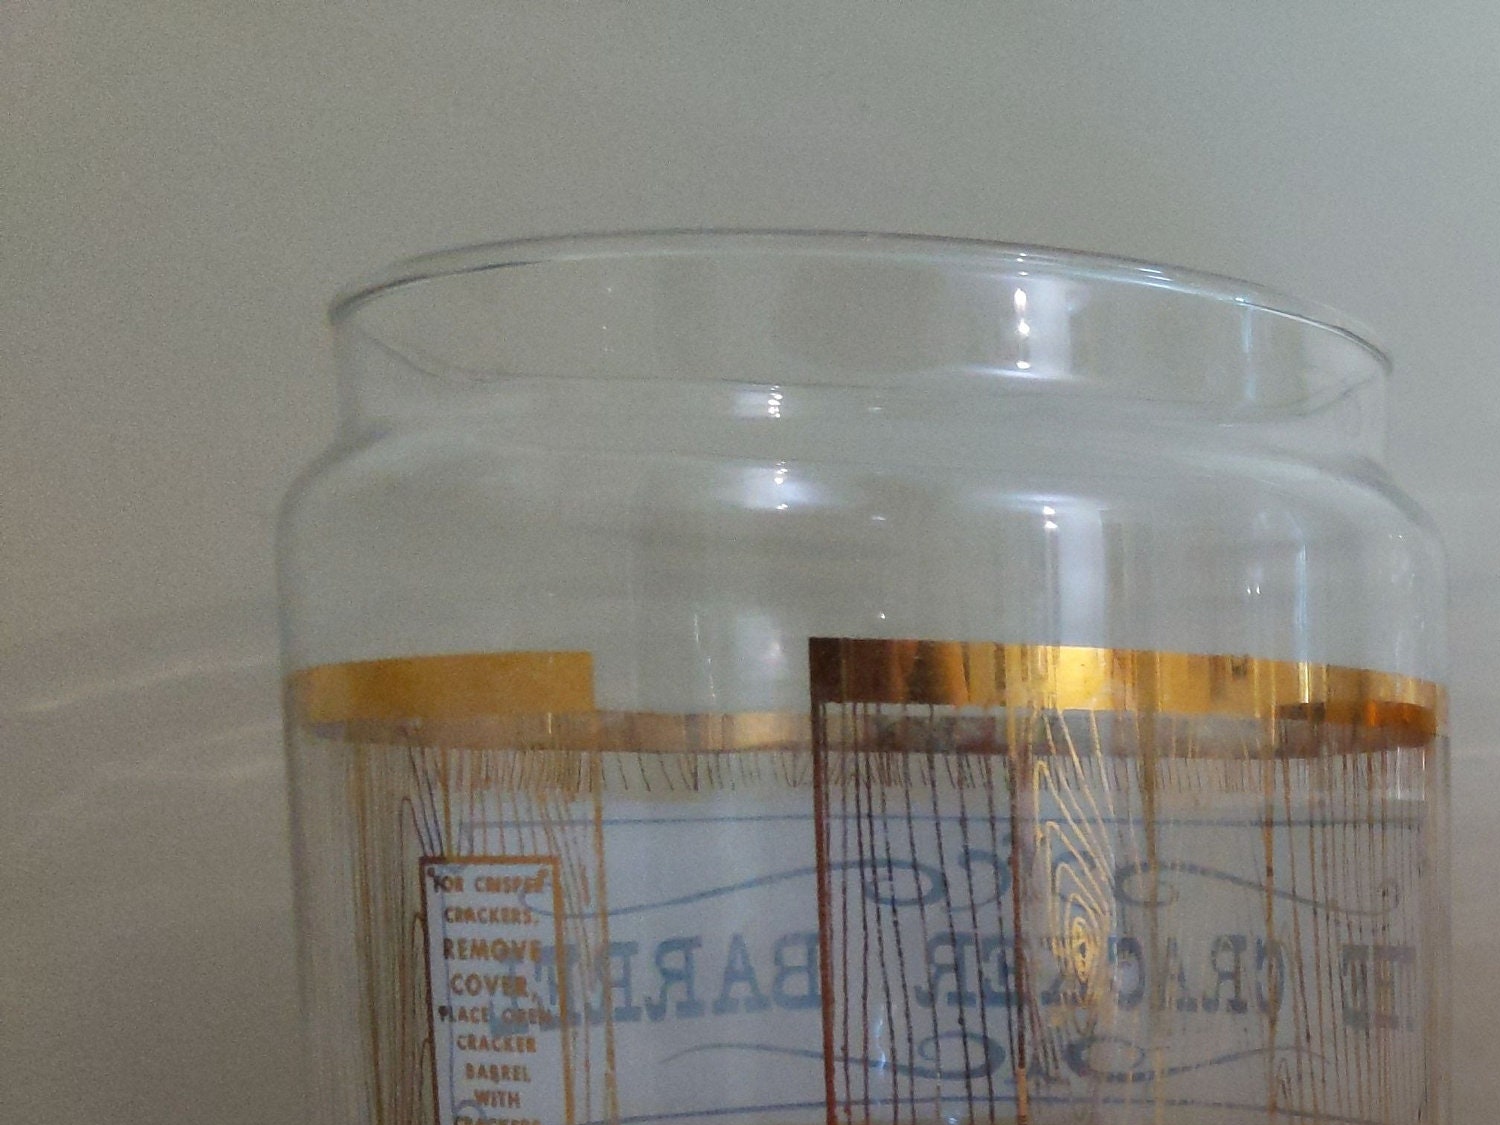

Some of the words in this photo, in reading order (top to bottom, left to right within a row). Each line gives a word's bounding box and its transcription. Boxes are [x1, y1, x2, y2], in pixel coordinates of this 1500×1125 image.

[443, 937, 543, 965] REMOVE
[456, 1033, 537, 1054] CRACKER
[465, 1062, 532, 1084] BARREL
[473, 1088, 522, 1109] WITH
